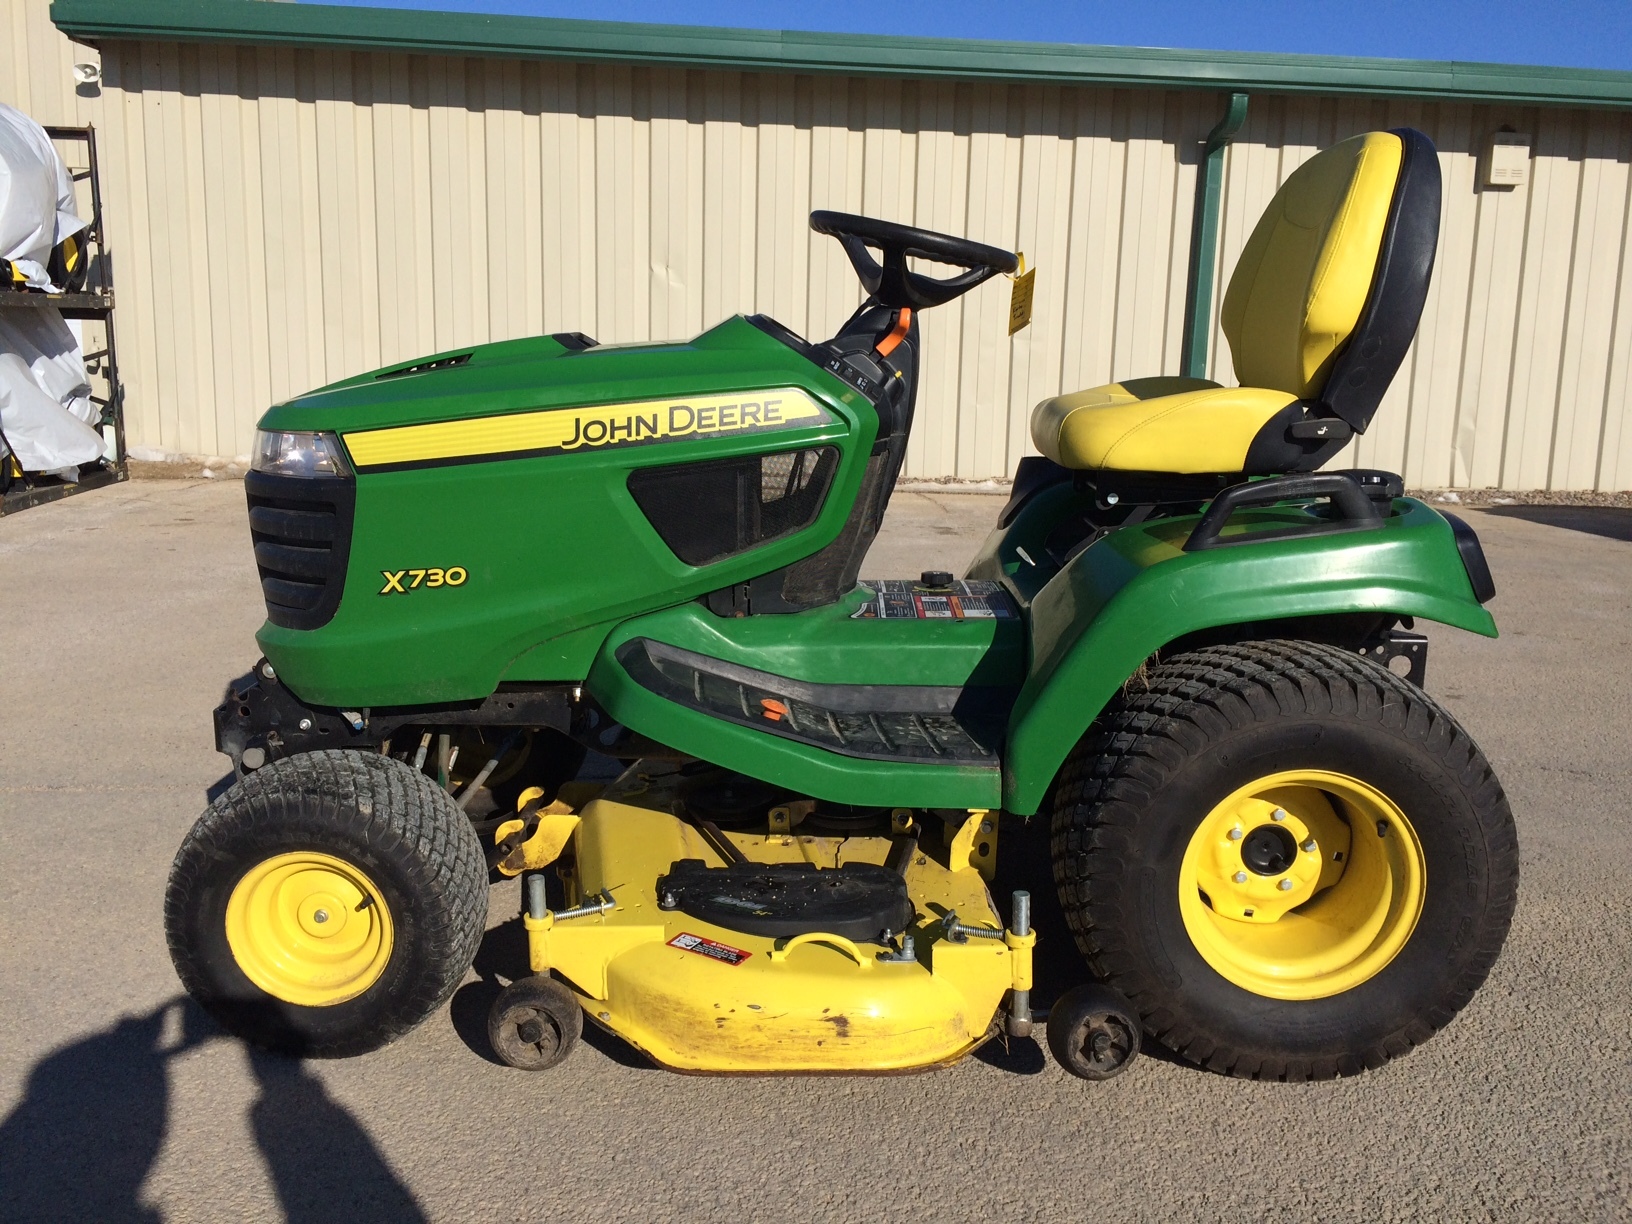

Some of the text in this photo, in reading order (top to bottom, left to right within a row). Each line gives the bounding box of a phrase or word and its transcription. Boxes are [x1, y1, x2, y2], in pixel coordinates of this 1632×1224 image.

[561, 400, 783, 446] JOHN DEERE
[377, 566, 469, 596] X730
